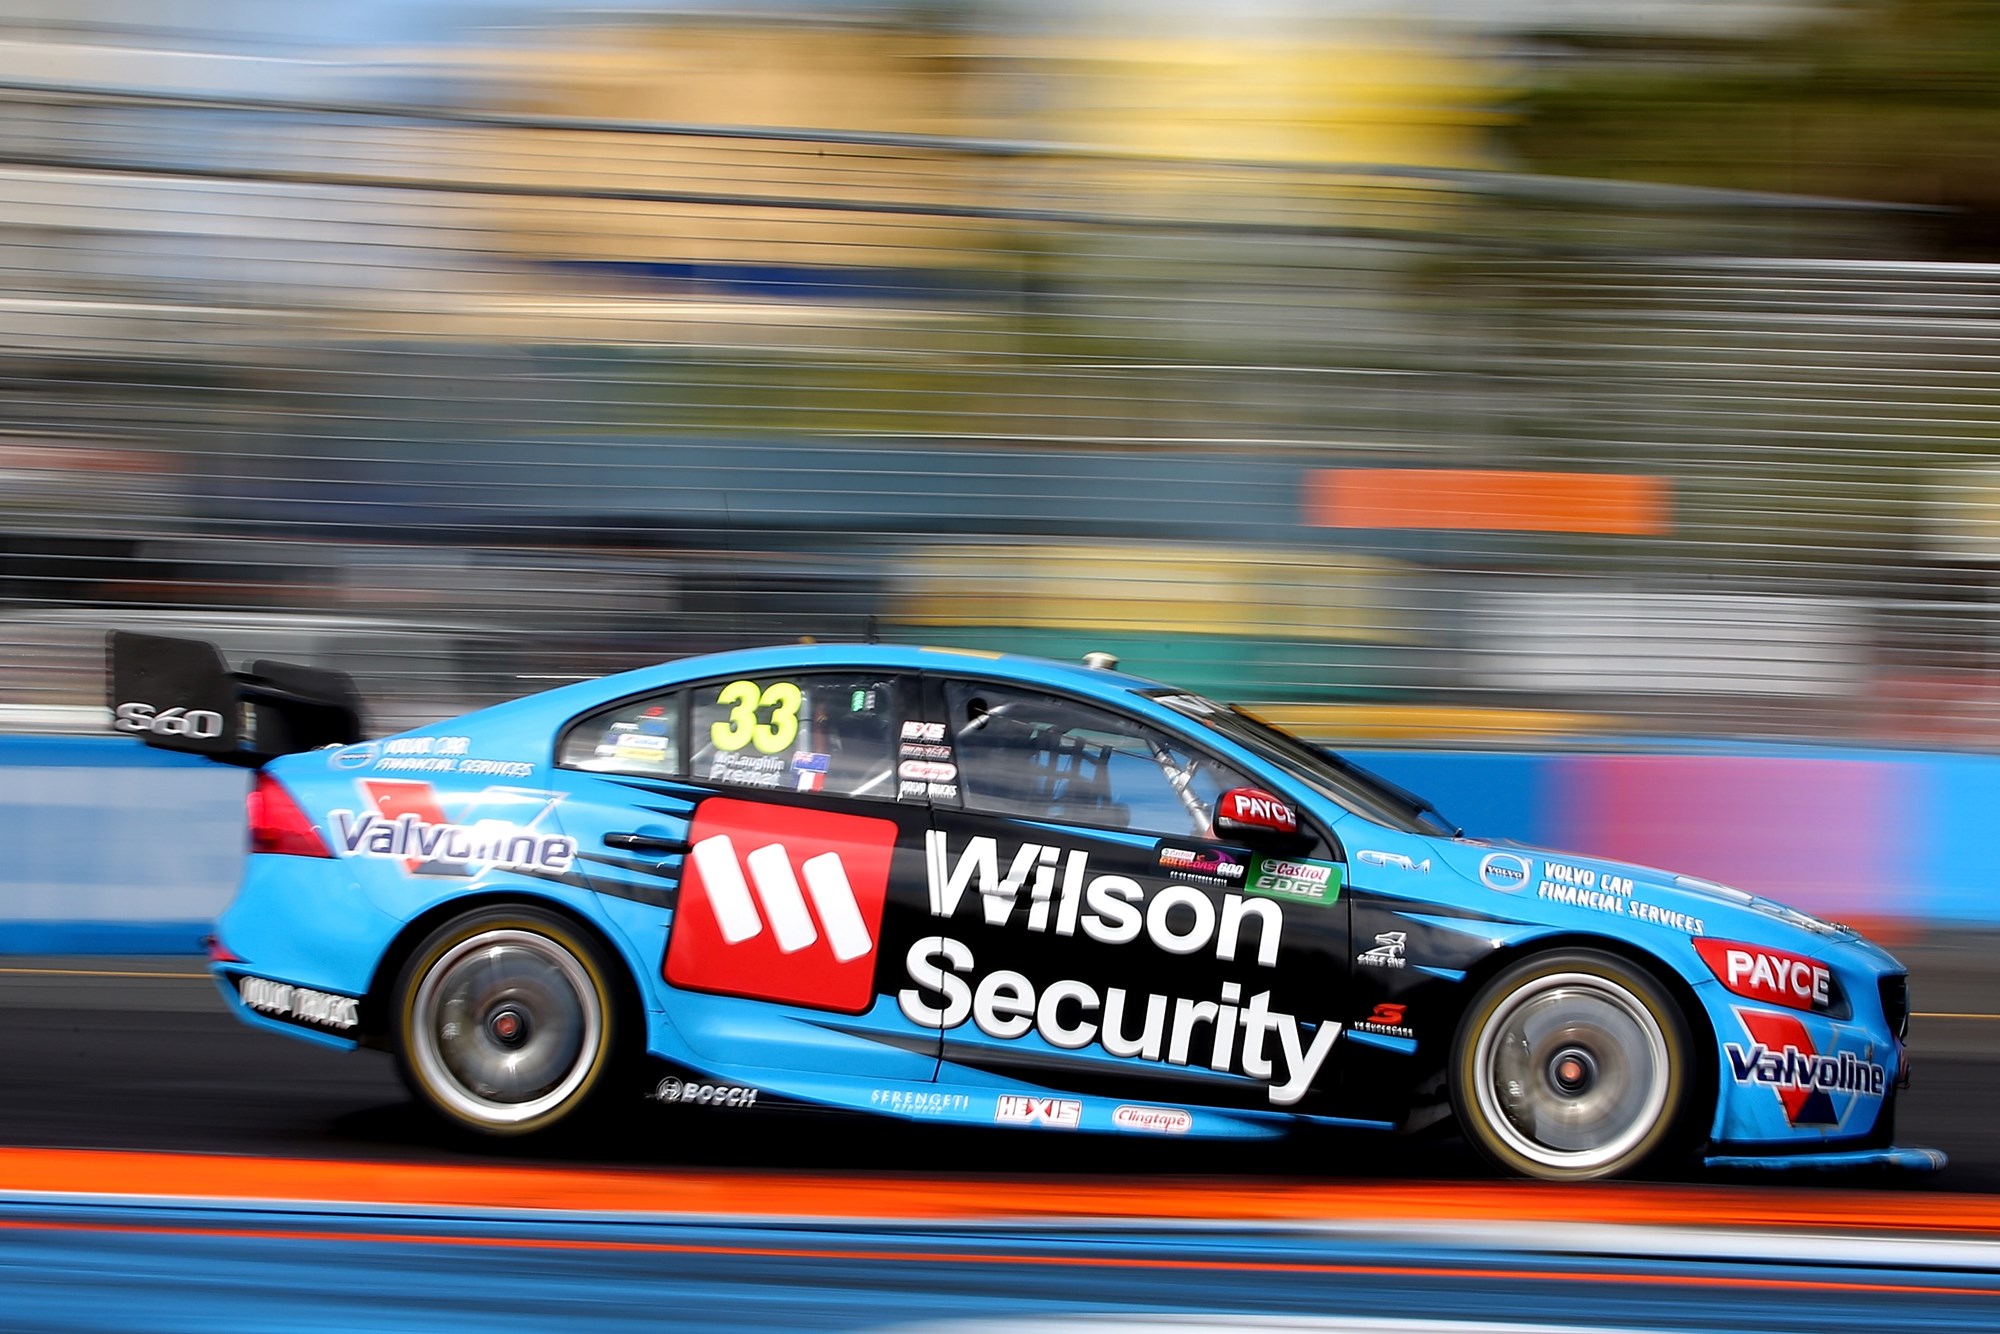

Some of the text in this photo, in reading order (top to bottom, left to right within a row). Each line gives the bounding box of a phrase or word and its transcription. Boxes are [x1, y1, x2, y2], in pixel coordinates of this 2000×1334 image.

[116, 702, 224, 739] S60
[710, 680, 801, 754] 33
[1234, 795, 1297, 825] PAYCE
[1255, 876, 1327, 898] EDGE
[1276, 862, 1326, 882] Castrol
[1487, 865, 1523, 880] VOLVO
[1544, 861, 1634, 899] VOLVO CAR
[926, 829, 1283, 967] Wilson
[1537, 880, 1704, 936] FINANCIAL SERVICES
[1727, 950, 1830, 1006] PAYCE
[899, 936, 1342, 1105] Security
[1724, 1042, 1884, 1096] Valvoline
[681, 1082, 758, 1107] BOSCH
[871, 1089, 969, 1111] SERENGETI
[997, 1095, 1081, 1128] HEXIS
[1118, 1108, 1186, 1132] Clingtape
